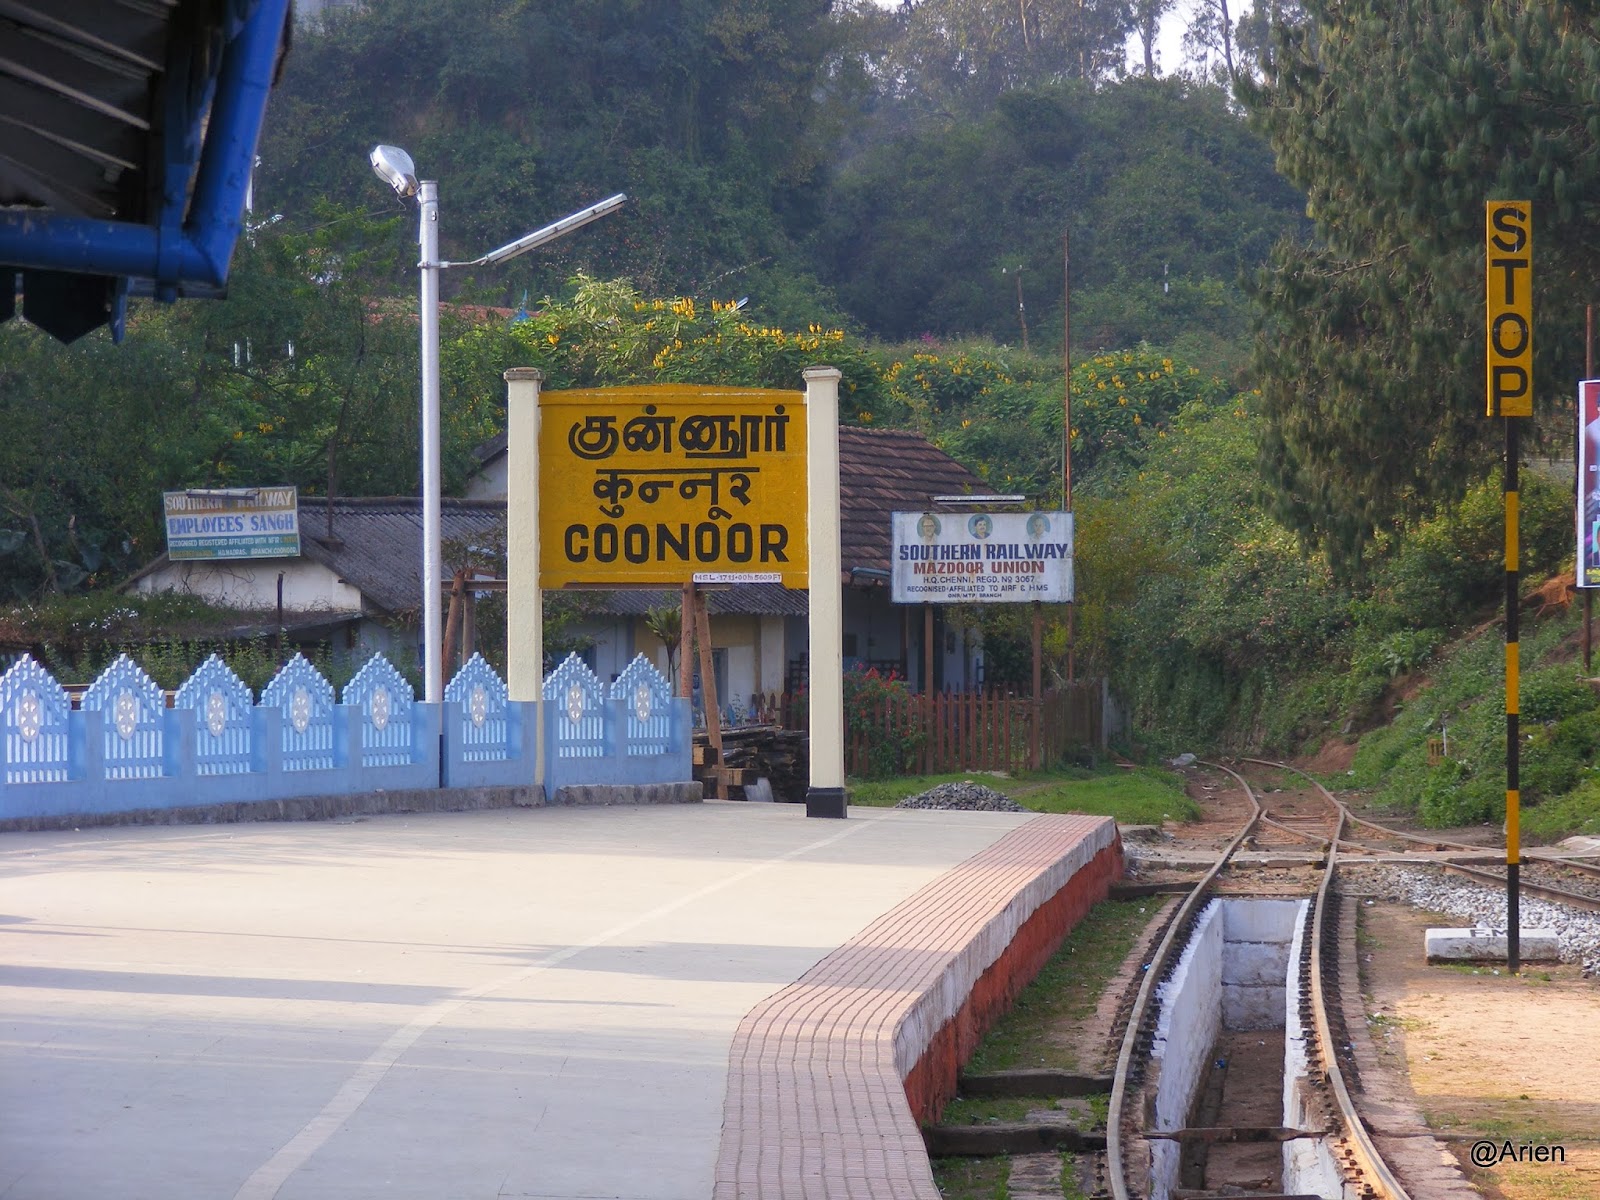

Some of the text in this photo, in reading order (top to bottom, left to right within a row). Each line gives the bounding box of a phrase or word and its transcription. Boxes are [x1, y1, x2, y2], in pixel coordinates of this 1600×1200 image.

[1491, 207, 1528, 413] STOP
[593, 467, 760, 520] कुन्नूर
[251, 514, 294, 531] SANGH
[564, 522, 790, 564] COONOOR
[900, 543, 1068, 560] SOUTHERN RAILWAY
[913, 560, 1045, 574] MAZDOOR UNION
[989, 584, 998, 592] TO
[1001, 584, 1017, 592] AIRF
